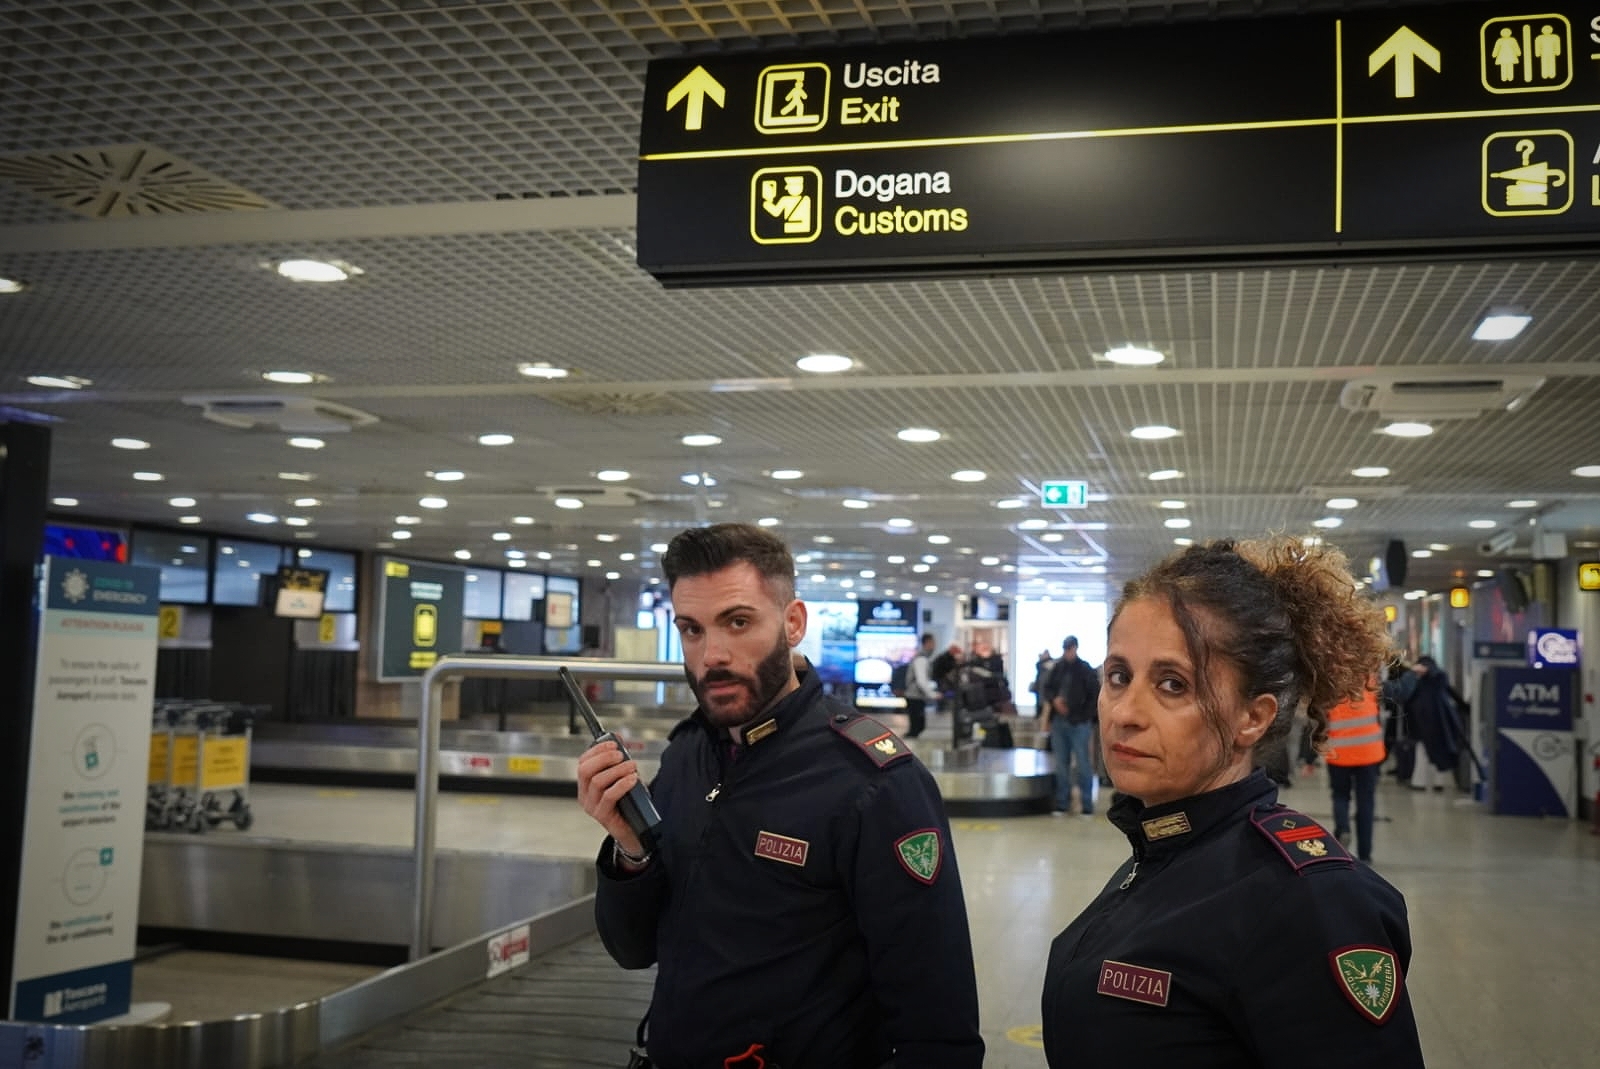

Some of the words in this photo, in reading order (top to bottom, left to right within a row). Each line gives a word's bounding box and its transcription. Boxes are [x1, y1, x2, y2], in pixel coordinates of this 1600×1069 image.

[843, 60, 941, 88] Uscita
[840, 96, 900, 125] Exit
[835, 169, 951, 203] Dogana
[834, 206, 969, 235] Customs
[1508, 683, 1560, 703] ATM
[758, 837, 802, 860] POLIZIA
[1103, 968, 1164, 998] POLIZIA
[1343, 970, 1371, 1006] POLIZIA
